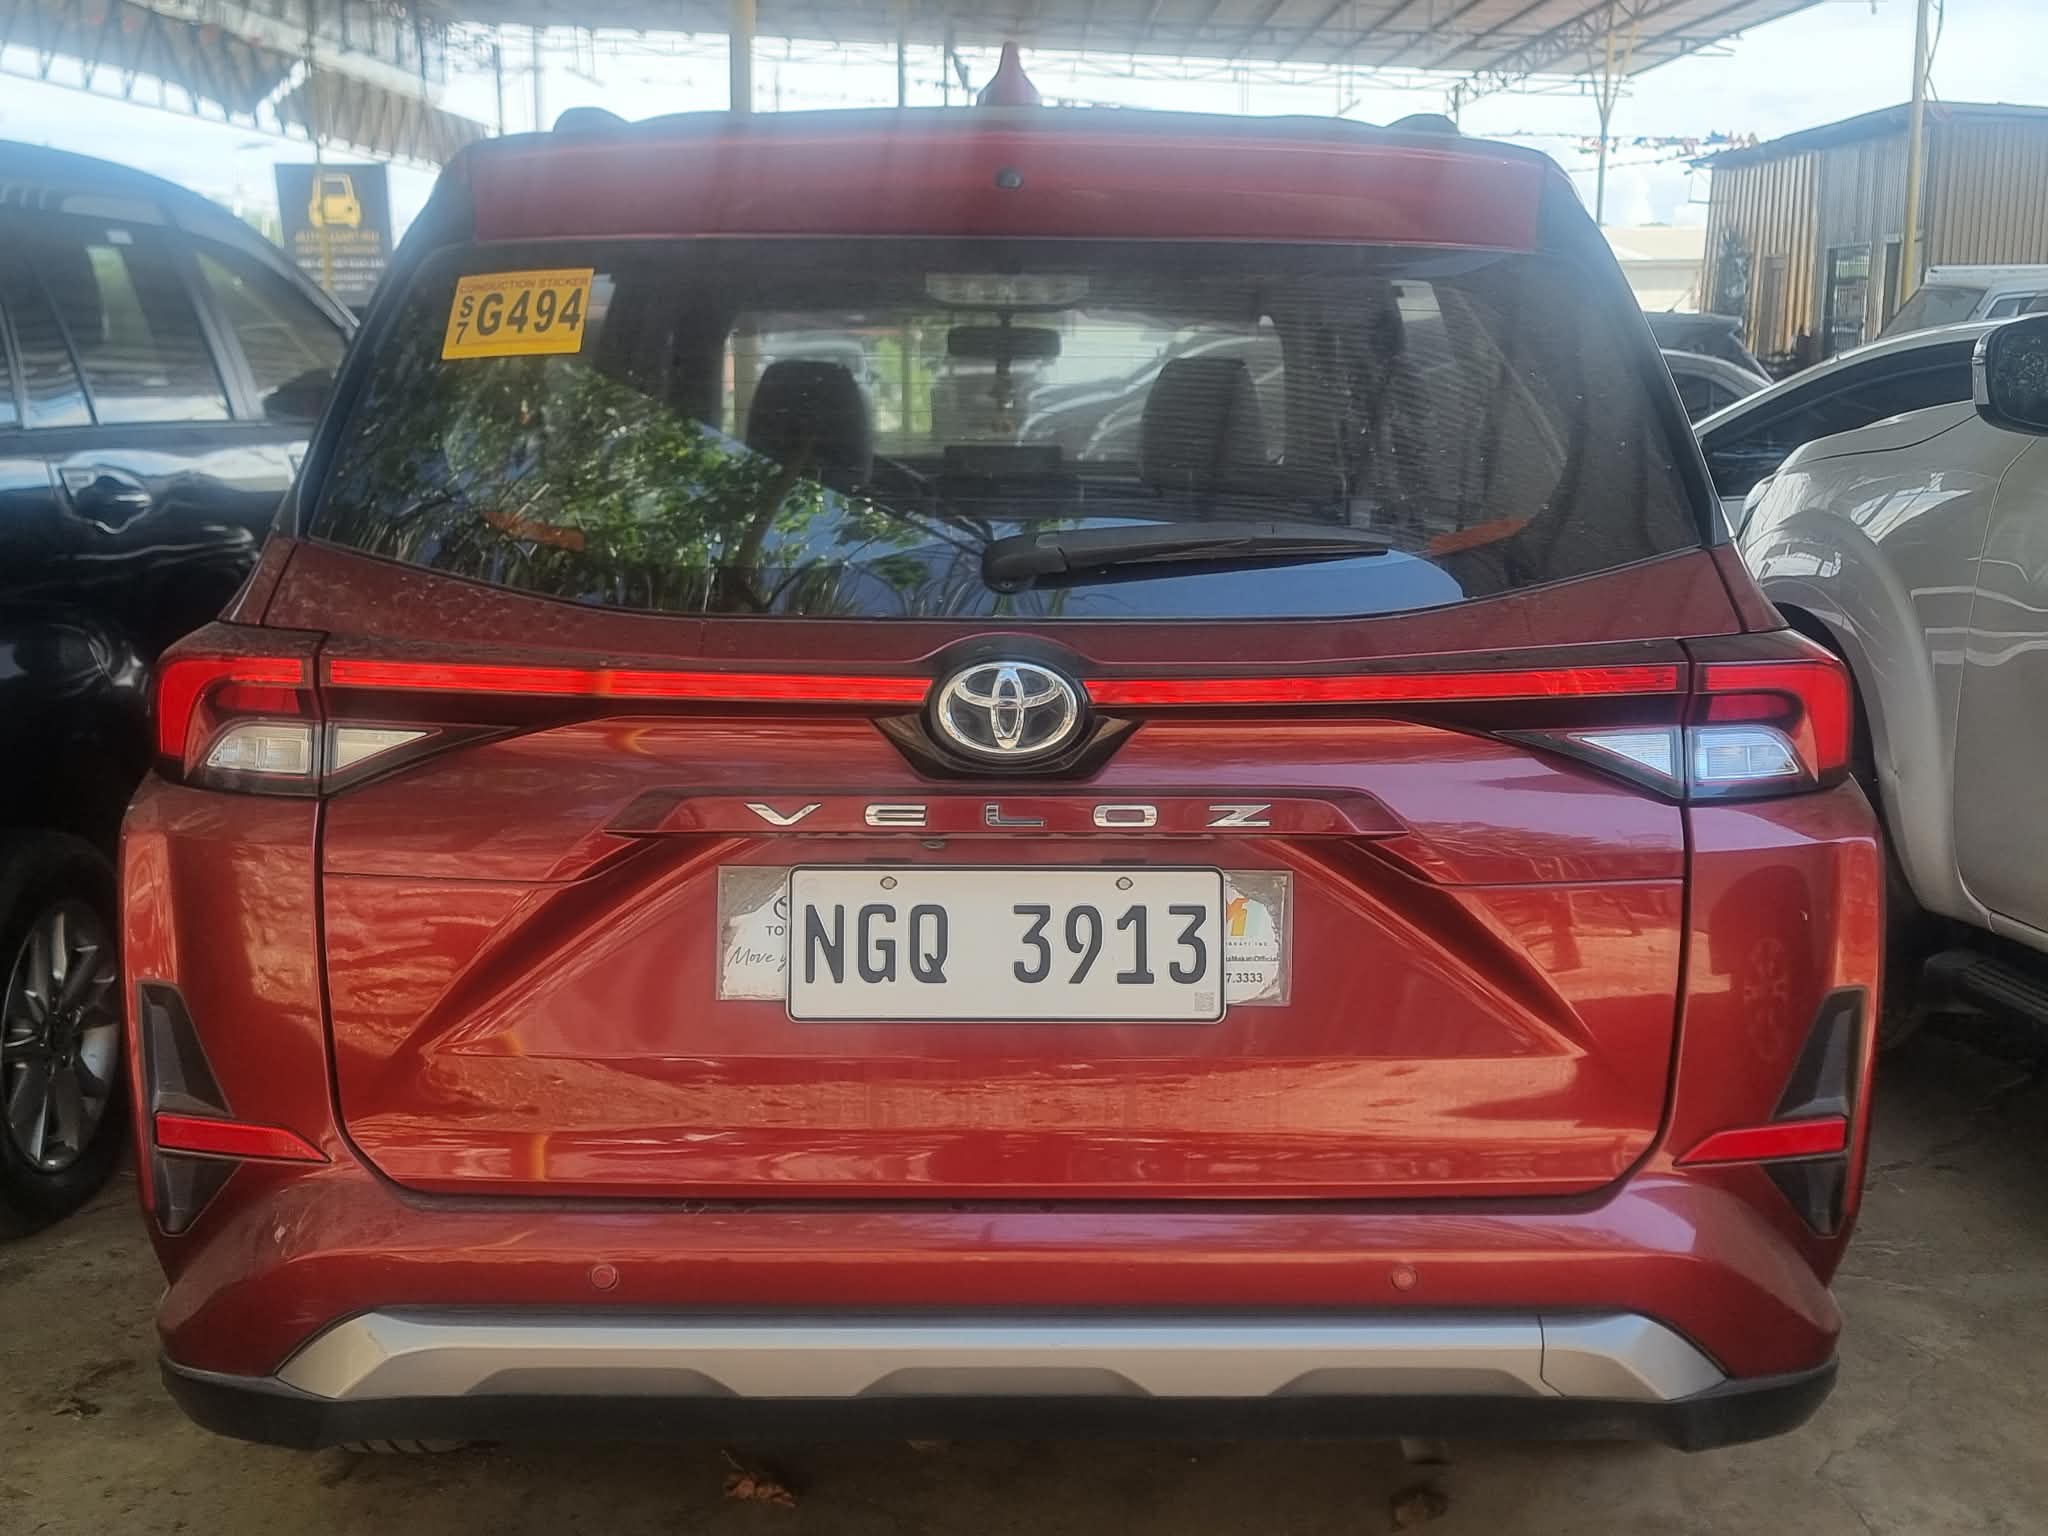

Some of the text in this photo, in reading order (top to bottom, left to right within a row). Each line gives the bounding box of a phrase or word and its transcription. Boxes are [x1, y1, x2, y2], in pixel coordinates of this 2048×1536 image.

[459, 294, 475, 319] S
[476, 287, 584, 336] G494
[456, 321, 469, 345] 7
[743, 802, 1272, 827] VELOZ
[765, 925, 787, 936] TO
[728, 946, 775, 967] Move
[805, 903, 1208, 985] NGQ 3913
